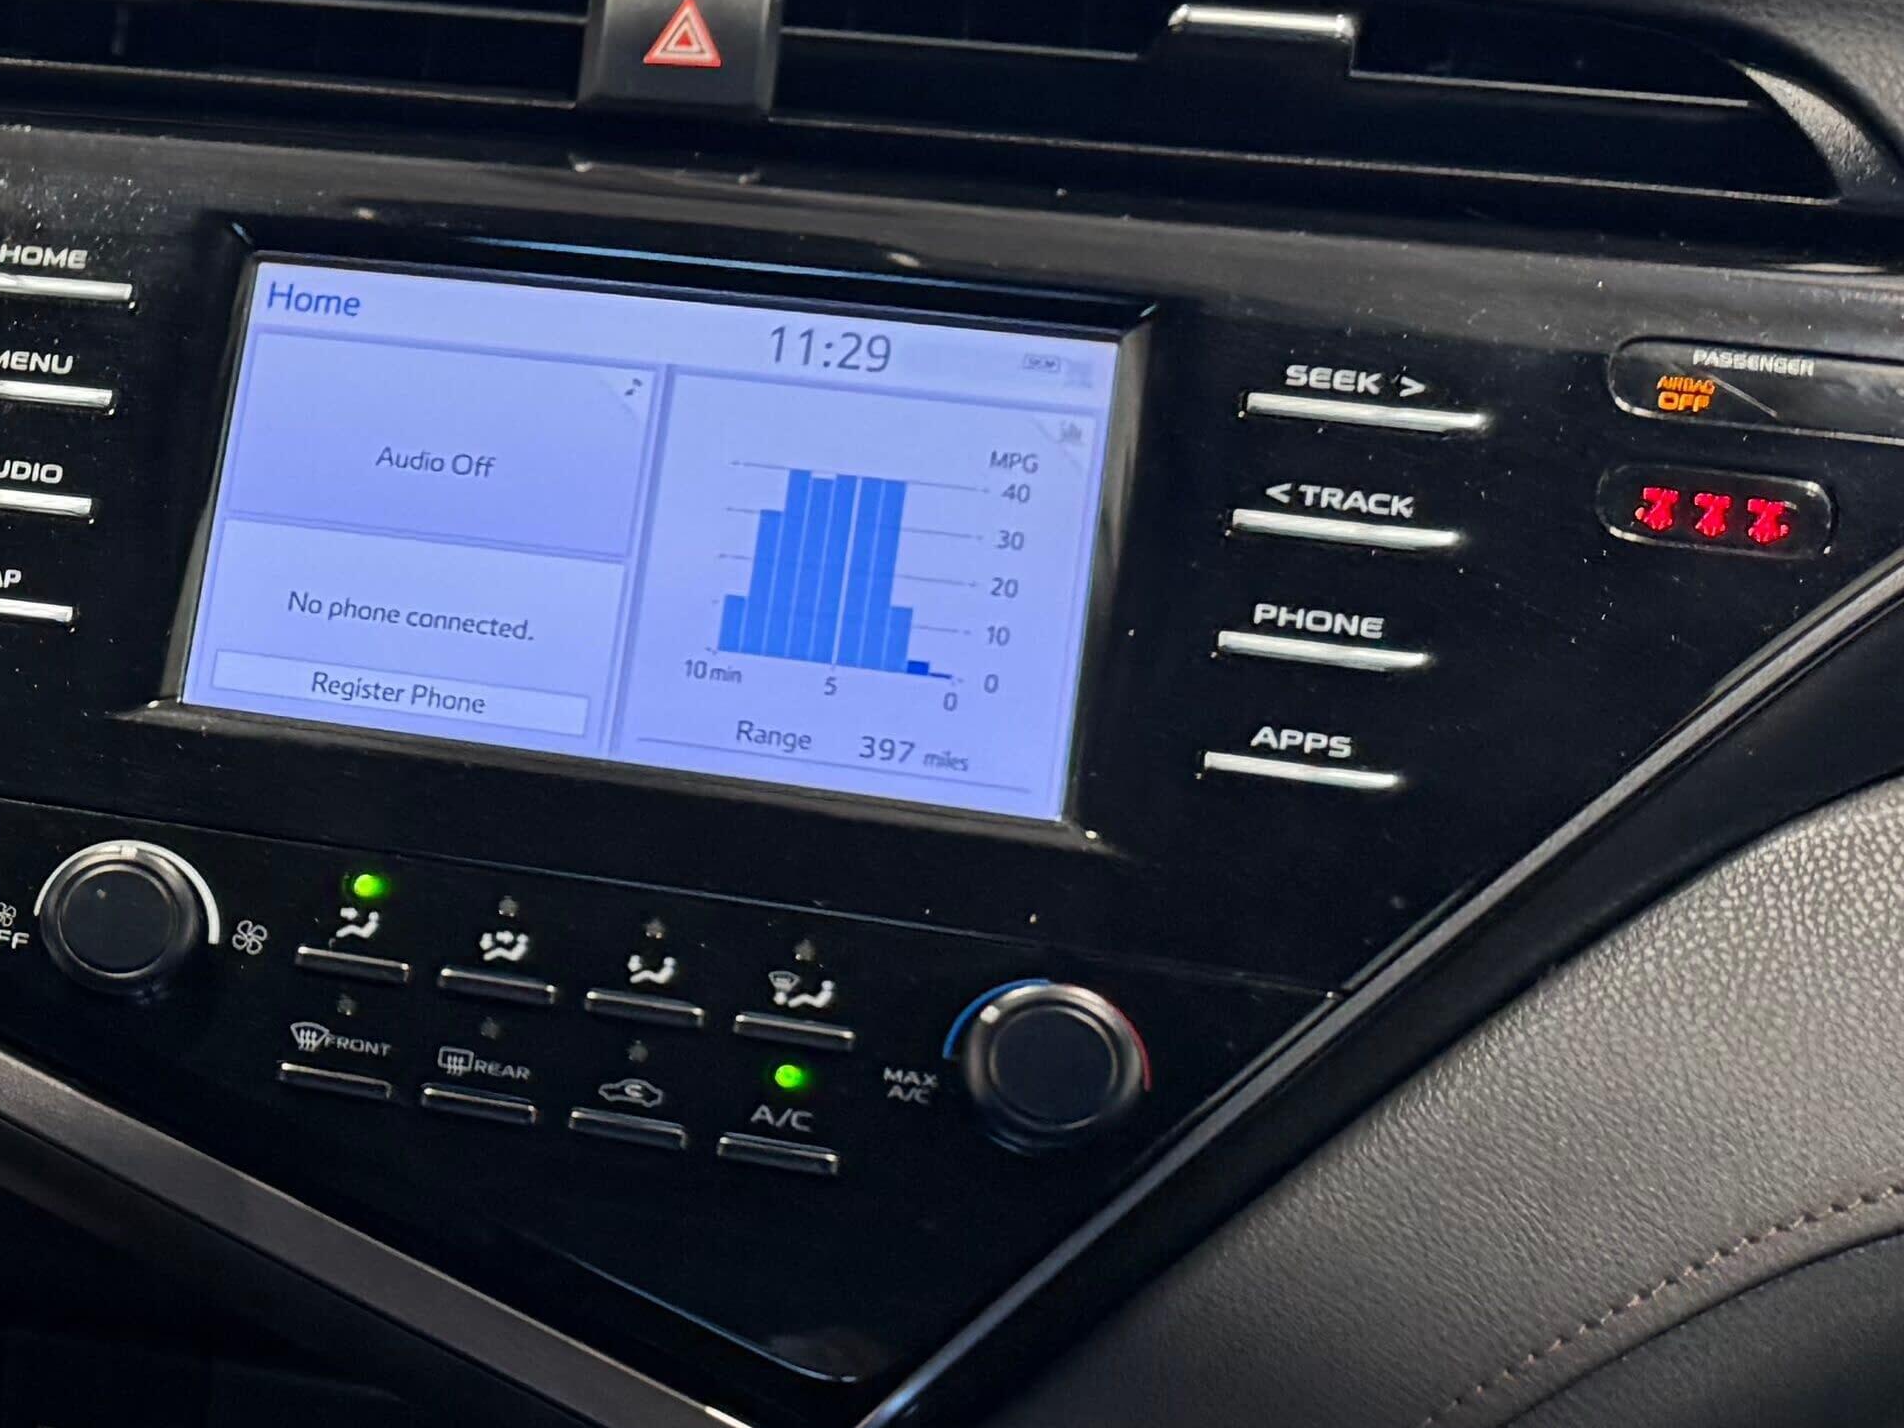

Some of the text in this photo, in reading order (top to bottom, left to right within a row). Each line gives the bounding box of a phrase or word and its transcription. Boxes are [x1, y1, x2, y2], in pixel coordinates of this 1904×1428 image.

[266, 281, 361, 318] Home
[769, 325, 892, 373] 11:29
[1692, 349, 1815, 378] PASSENGER
[1285, 364, 1383, 395] SEEK
[1657, 391, 1710, 413] OFF
[375, 445, 496, 478] Audio Off
[989, 450, 1039, 474] MPG
[1001, 483, 1030, 504] 40
[1298, 483, 1415, 519] TRACK
[997, 531, 1025, 551] 30
[991, 578, 1018, 598] 20
[287, 590, 535, 642] No phone connected.
[1253, 602, 1385, 640] PHONE
[985, 626, 1010, 646] 10
[683, 660, 742, 685] 10 min
[984, 673, 999, 694] 0
[311, 671, 486, 716] Register Phone
[824, 677, 837, 696] 5
[943, 691, 958, 713] 0
[735, 720, 969, 773] Range 397 miles
[1250, 725, 1353, 759] APPS
[324, 1033, 391, 1059] FRONT
[473, 1058, 531, 1081] REAR
[883, 1066, 938, 1088] MAX
[888, 1085, 931, 1106] A/C
[749, 1105, 814, 1133] A/C
